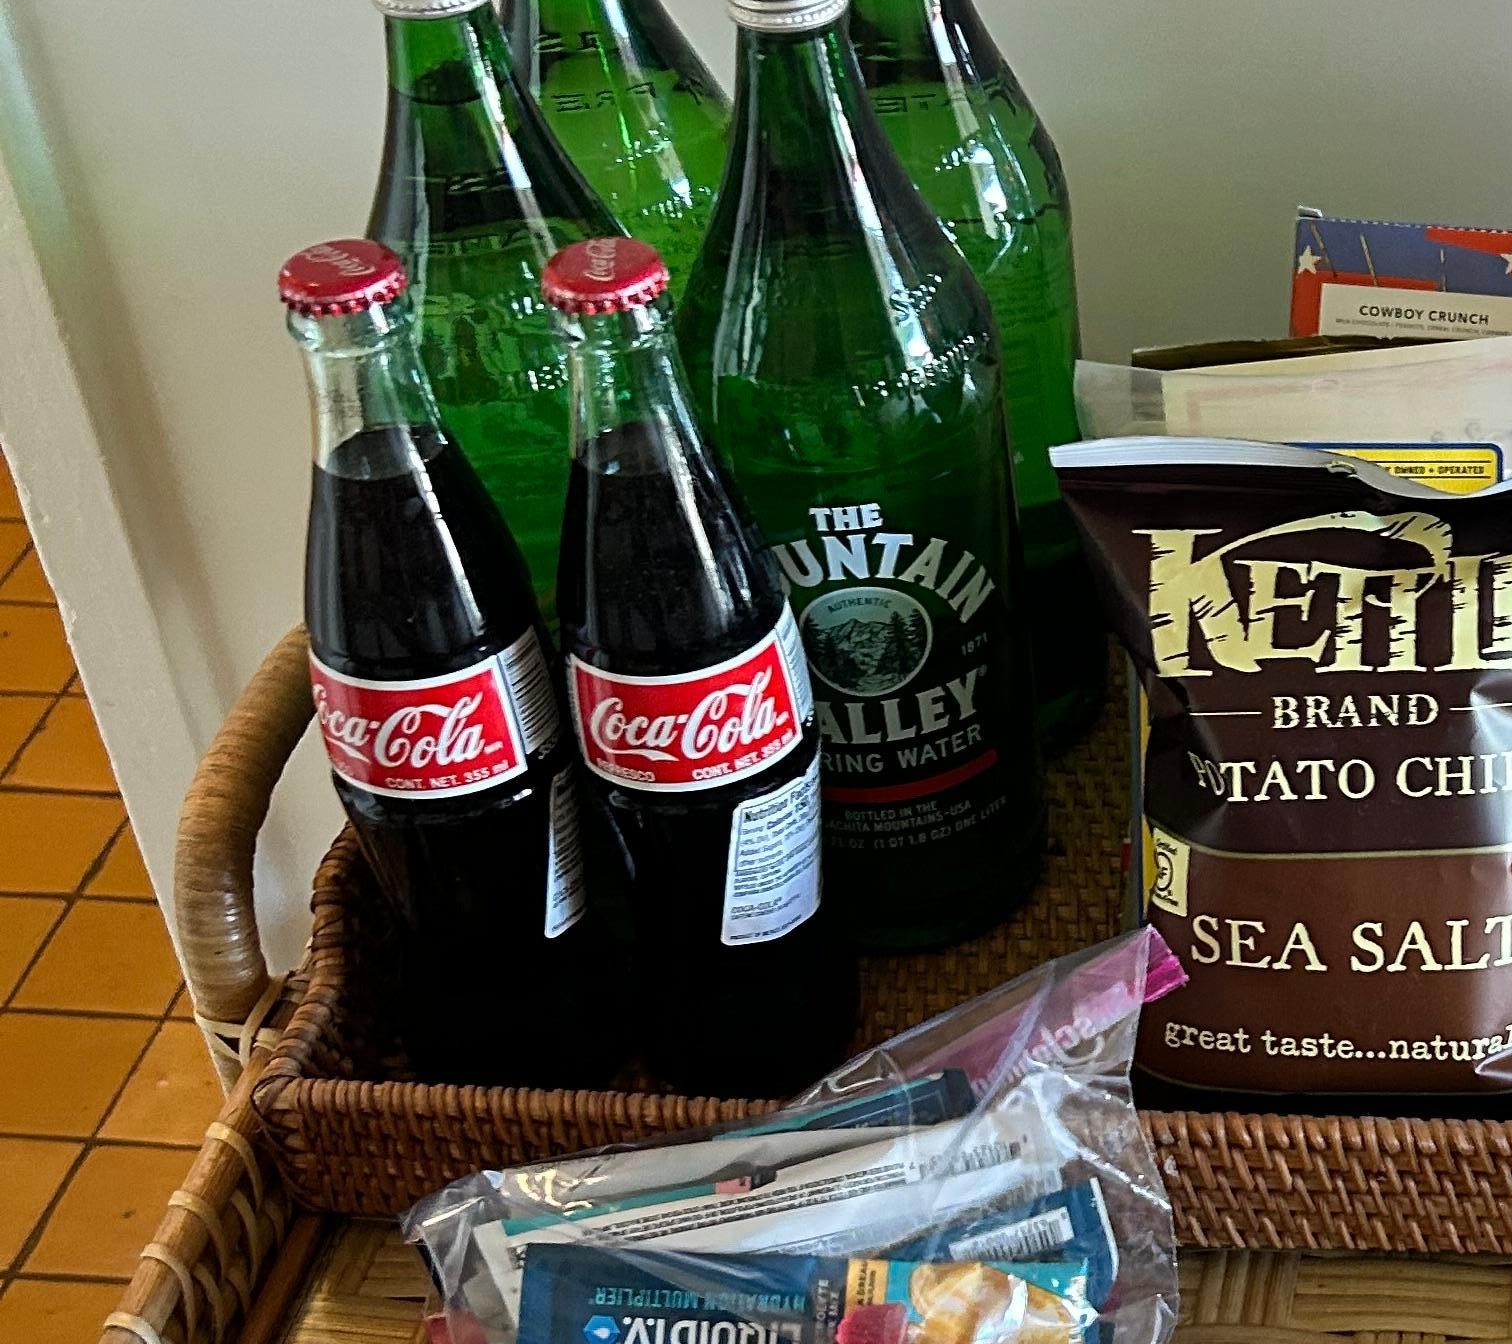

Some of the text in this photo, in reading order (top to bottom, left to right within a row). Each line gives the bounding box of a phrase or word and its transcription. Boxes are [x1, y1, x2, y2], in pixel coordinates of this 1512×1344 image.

[1358, 304, 1425, 321] COWBOY
[1428, 309, 1490, 326] CRUNCH
[808, 502, 885, 533] THE
[770, 532, 997, 624] UNTAIN
[826, 594, 894, 614] AUTHENTIC
[589, 663, 778, 761] Coca-Cola
[817, 666, 982, 745] ALLEY
[1272, 693, 1440, 729] BRAND
[312, 682, 487, 769] Coca-Cola
[820, 722, 983, 774] RING WATER
[463, 766, 489, 783] 355
[825, 818, 871, 833] ACHITA
[1190, 914, 1329, 972] SEA
[1163, 1018, 1254, 1056] great
[594, 1286, 702, 1312] MULTIPLIER
